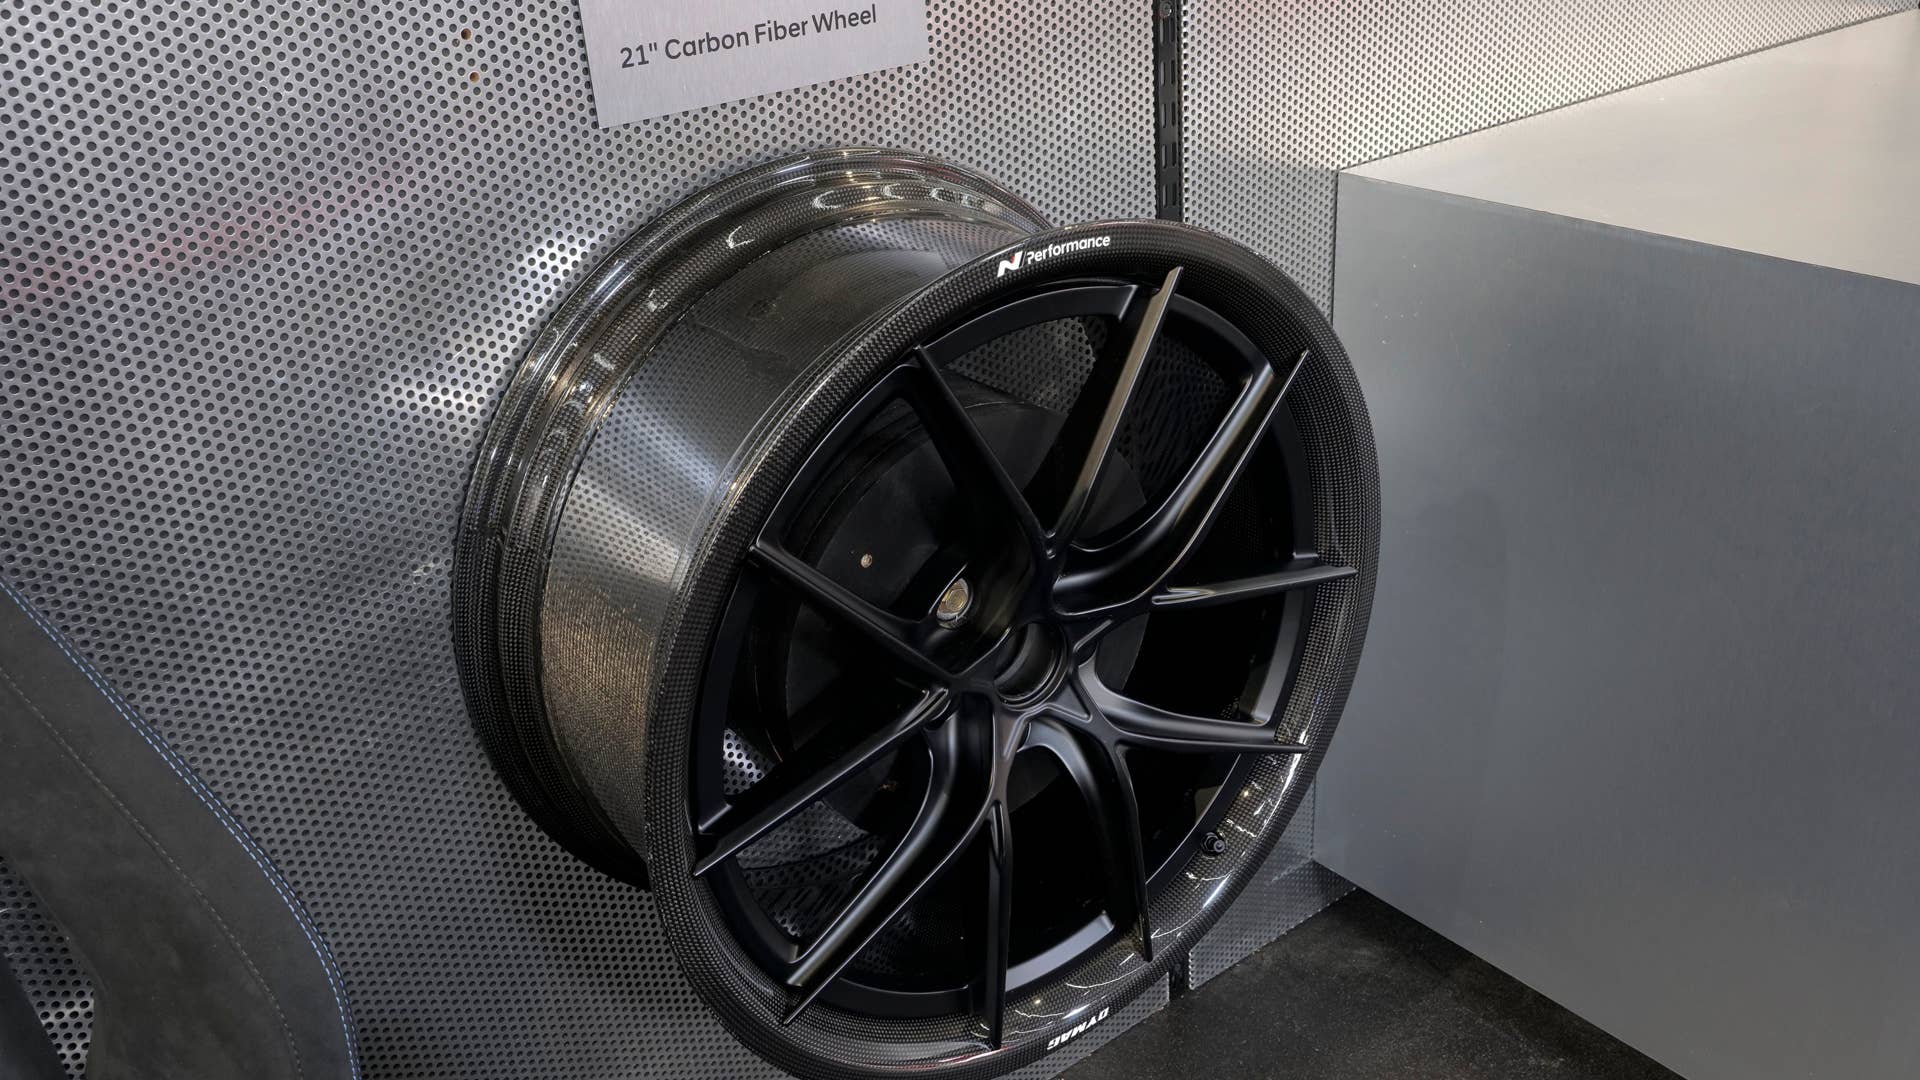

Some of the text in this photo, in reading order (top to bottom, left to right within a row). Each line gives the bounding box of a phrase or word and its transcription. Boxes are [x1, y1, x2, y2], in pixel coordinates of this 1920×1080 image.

[620, 4, 877, 68] 21" Carbon Fiber Wheel
[1026, 236, 1111, 265] Performance
[1046, 1006, 1109, 1051] DYMAG
